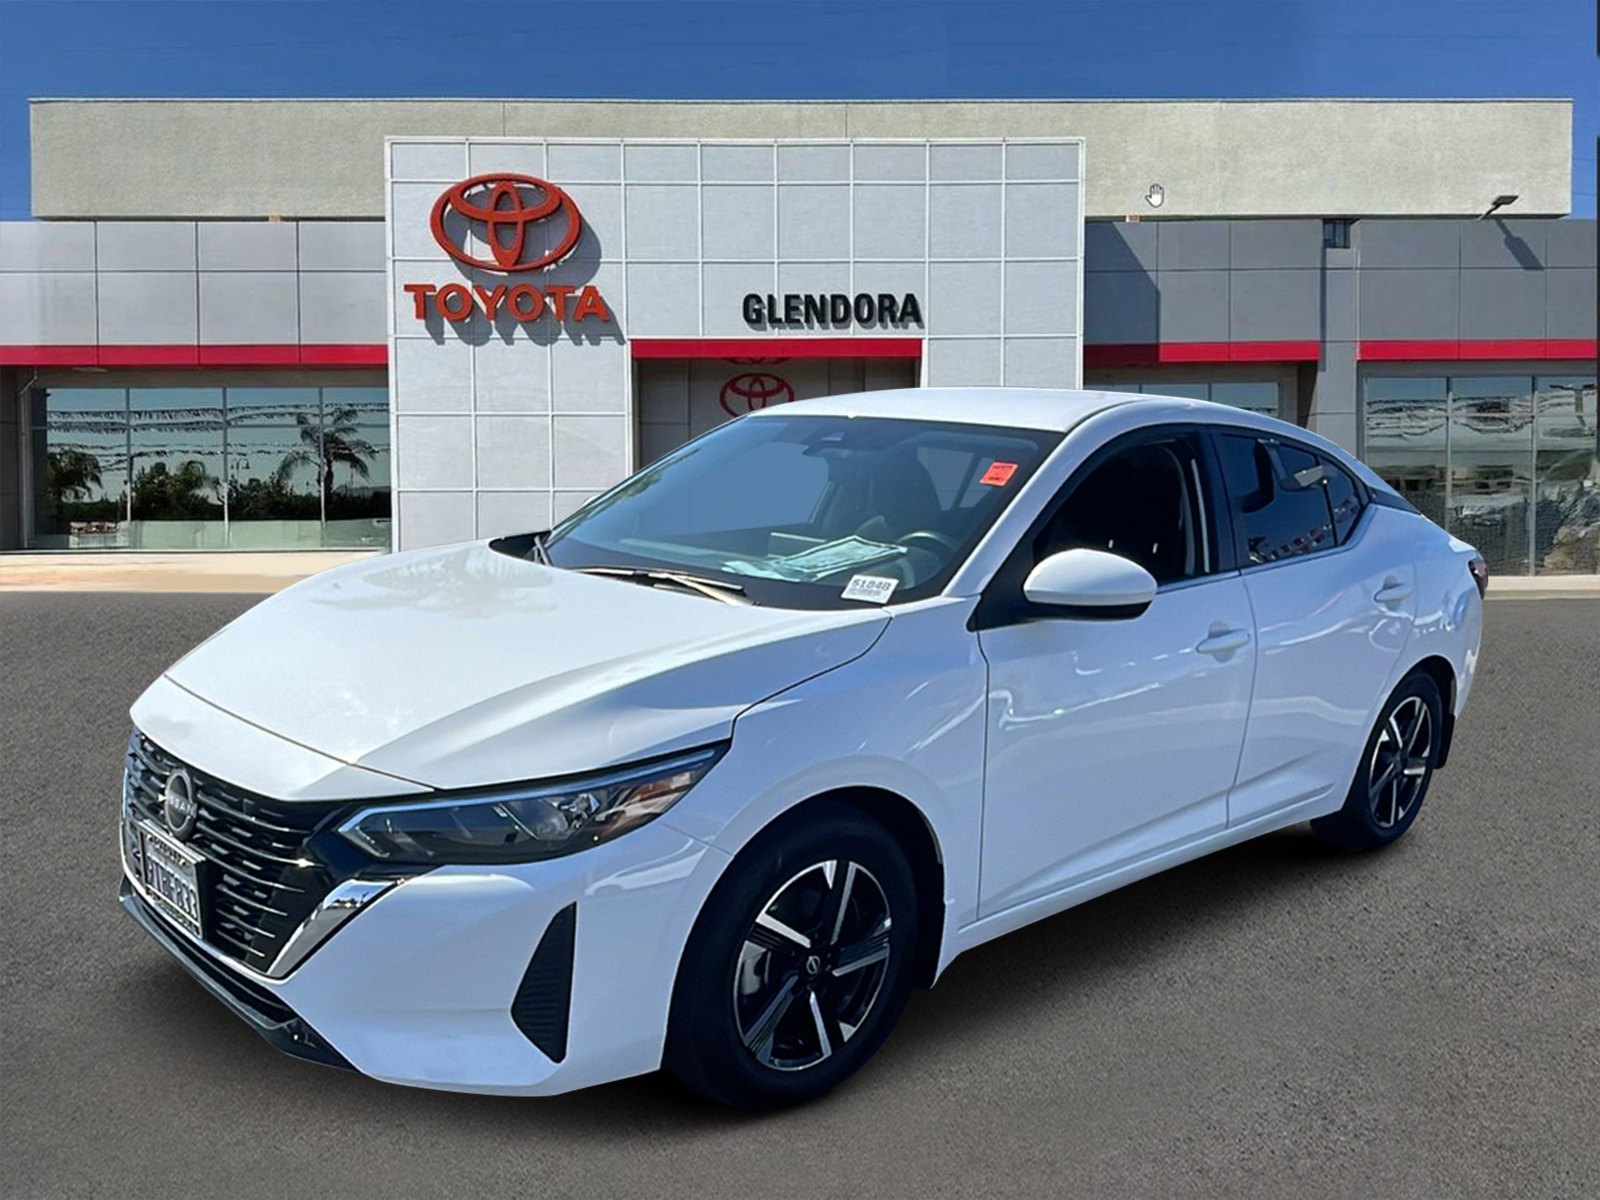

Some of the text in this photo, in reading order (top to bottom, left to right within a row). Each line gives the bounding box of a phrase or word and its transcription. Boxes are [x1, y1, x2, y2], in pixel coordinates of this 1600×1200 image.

[404, 283, 610, 322] TOYOTA
[743, 293, 924, 328] GLENDORA
[166, 790, 197, 819] SSAN
